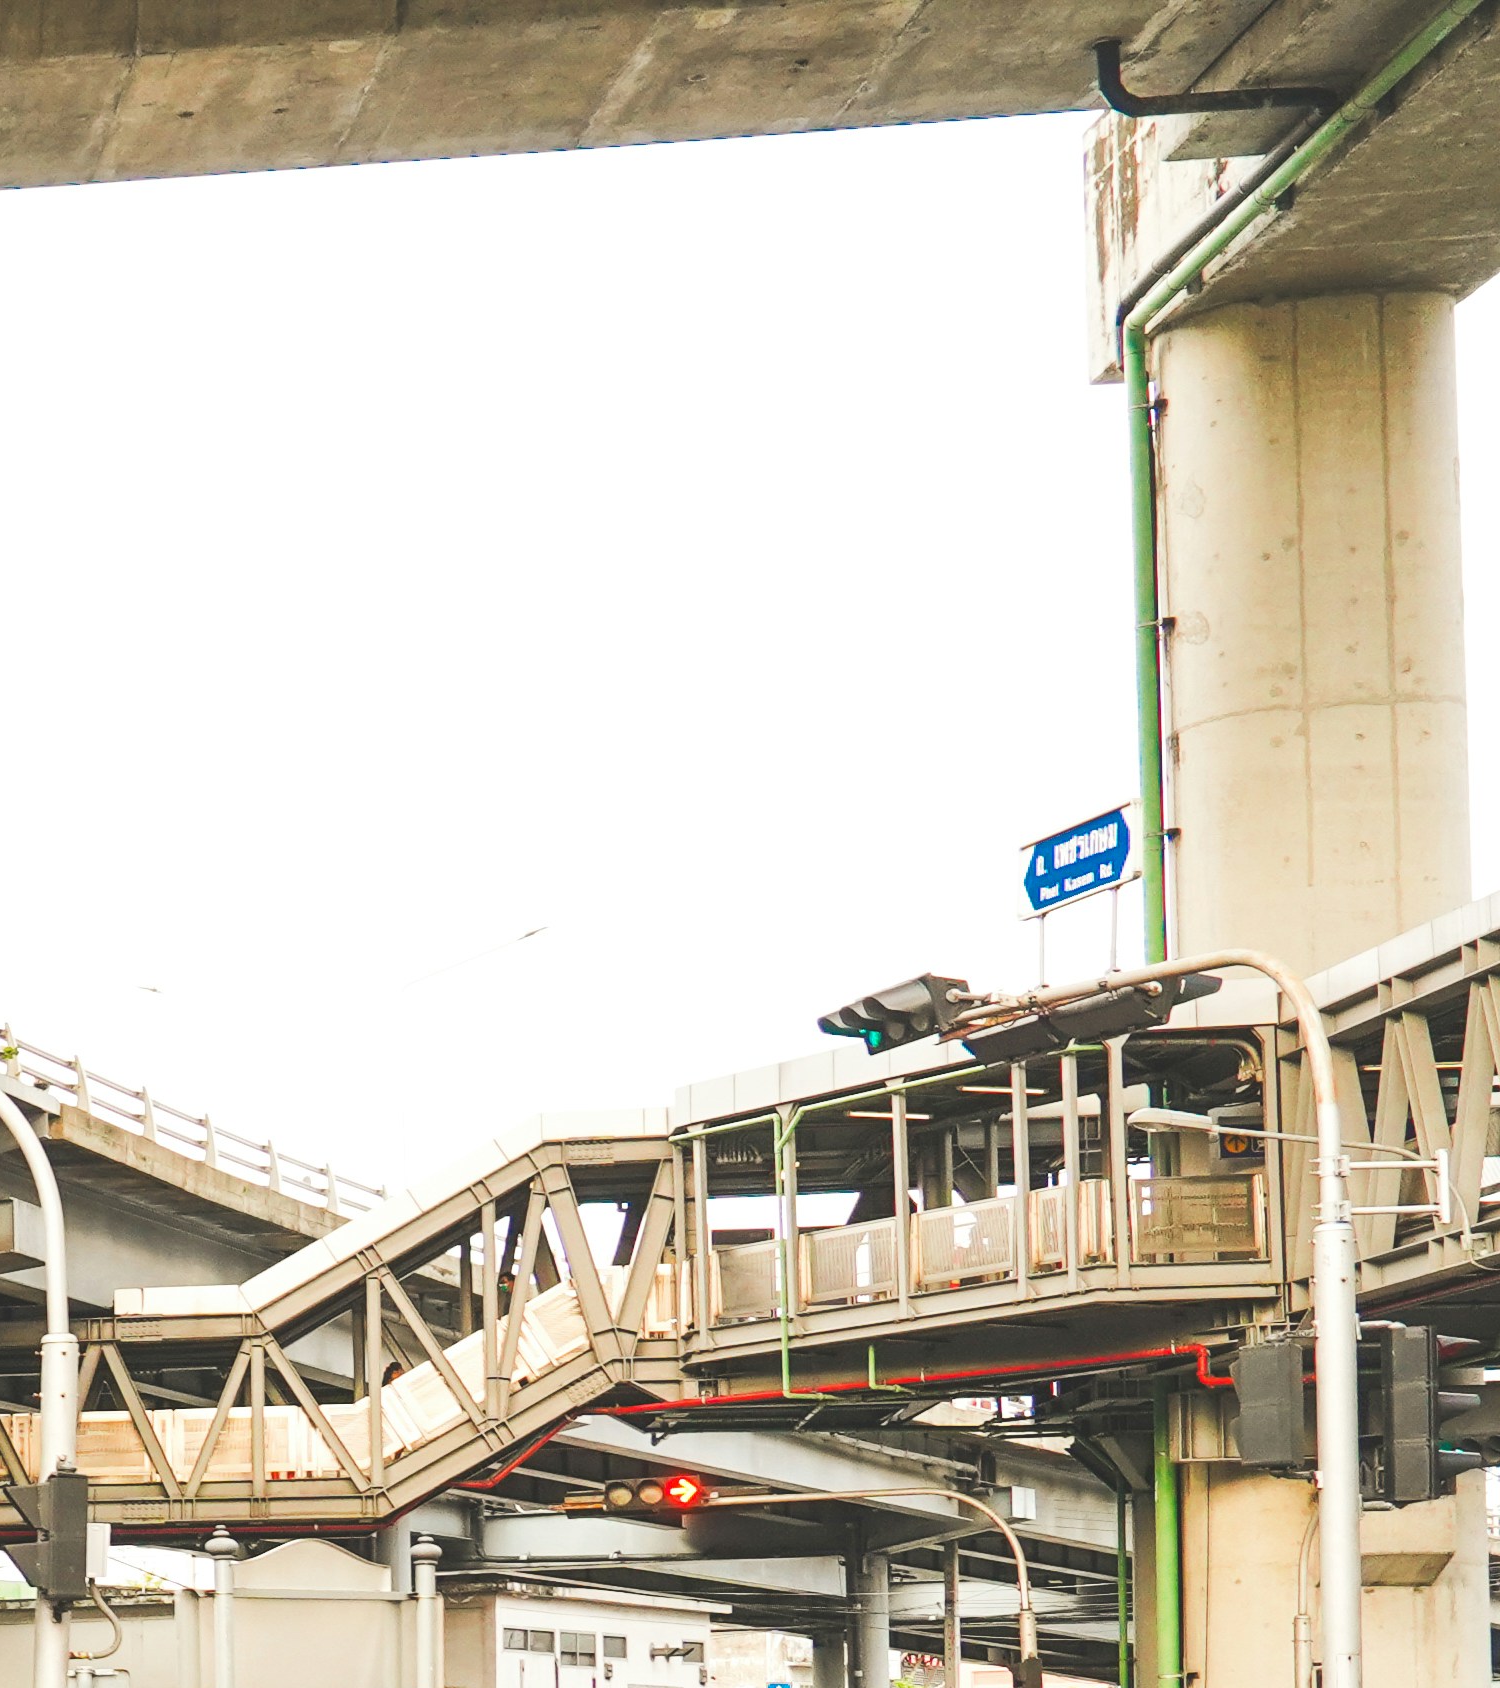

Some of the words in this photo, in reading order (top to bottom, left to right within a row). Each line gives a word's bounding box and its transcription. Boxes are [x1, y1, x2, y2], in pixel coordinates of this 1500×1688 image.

[1054, 822, 1118, 869] เพชรเกษม
[1064, 872, 1095, 892] Kasem
